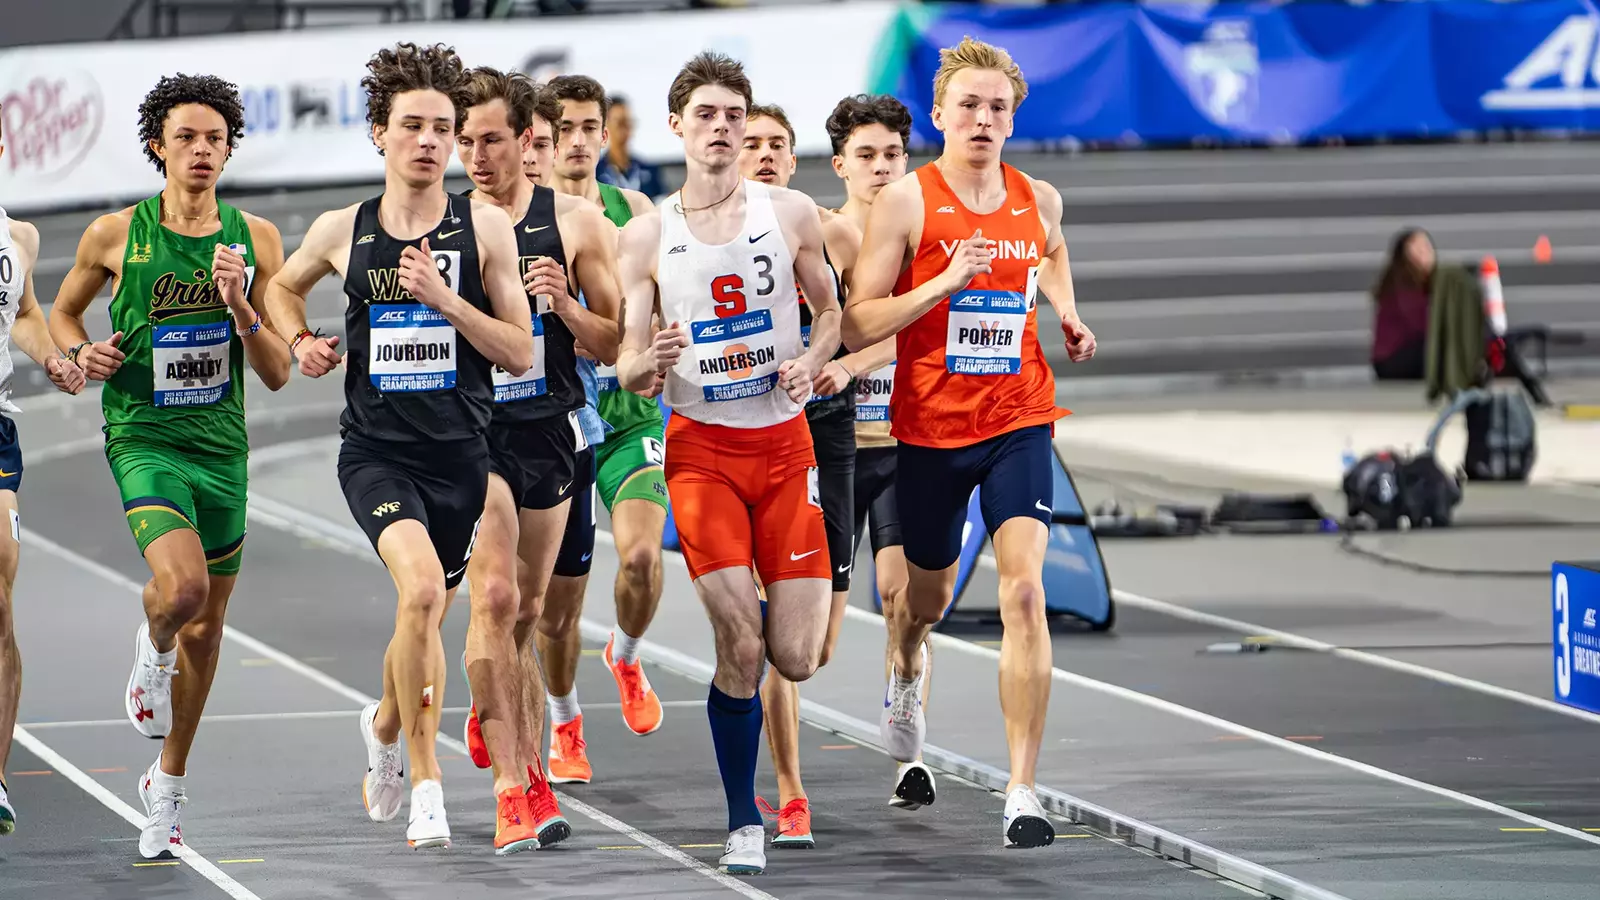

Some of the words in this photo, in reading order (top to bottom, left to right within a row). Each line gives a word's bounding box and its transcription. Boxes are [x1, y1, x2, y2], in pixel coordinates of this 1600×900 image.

[357, 234, 376, 245] ACC
[668, 244, 687, 254] ACC
[939, 239, 1039, 260] VGINIA
[127, 253, 151, 263] ACC
[753, 254, 775, 296] 3
[710, 273, 747, 319] S
[955, 295, 985, 307] ACC
[376, 311, 406, 322] ACC
[698, 324, 725, 338] ACC
[731, 319, 765, 333] GREATNESS
[158, 331, 189, 342] ACC
[195, 330, 227, 341] GREATNESS
[958, 327, 1013, 346] PORTER
[375, 342, 450, 362] JOURDON
[699, 345, 775, 375] ANDERSON
[166, 357, 223, 380] ACKLEY
[380, 379, 445, 391] CHAMPIONSHIPS
[713, 381, 772, 400] CHAMPIONSHIPS
[856, 378, 892, 395] KSON
[163, 392, 221, 405] CHAMPIONSHIPS
[494, 386, 537, 400] PIONSHIPS
[856, 411, 886, 420] ONSHIPS
[372, 501, 401, 517] WF
[1555, 572, 1571, 698] 3
[1573, 645, 1600, 677] GREATNE
